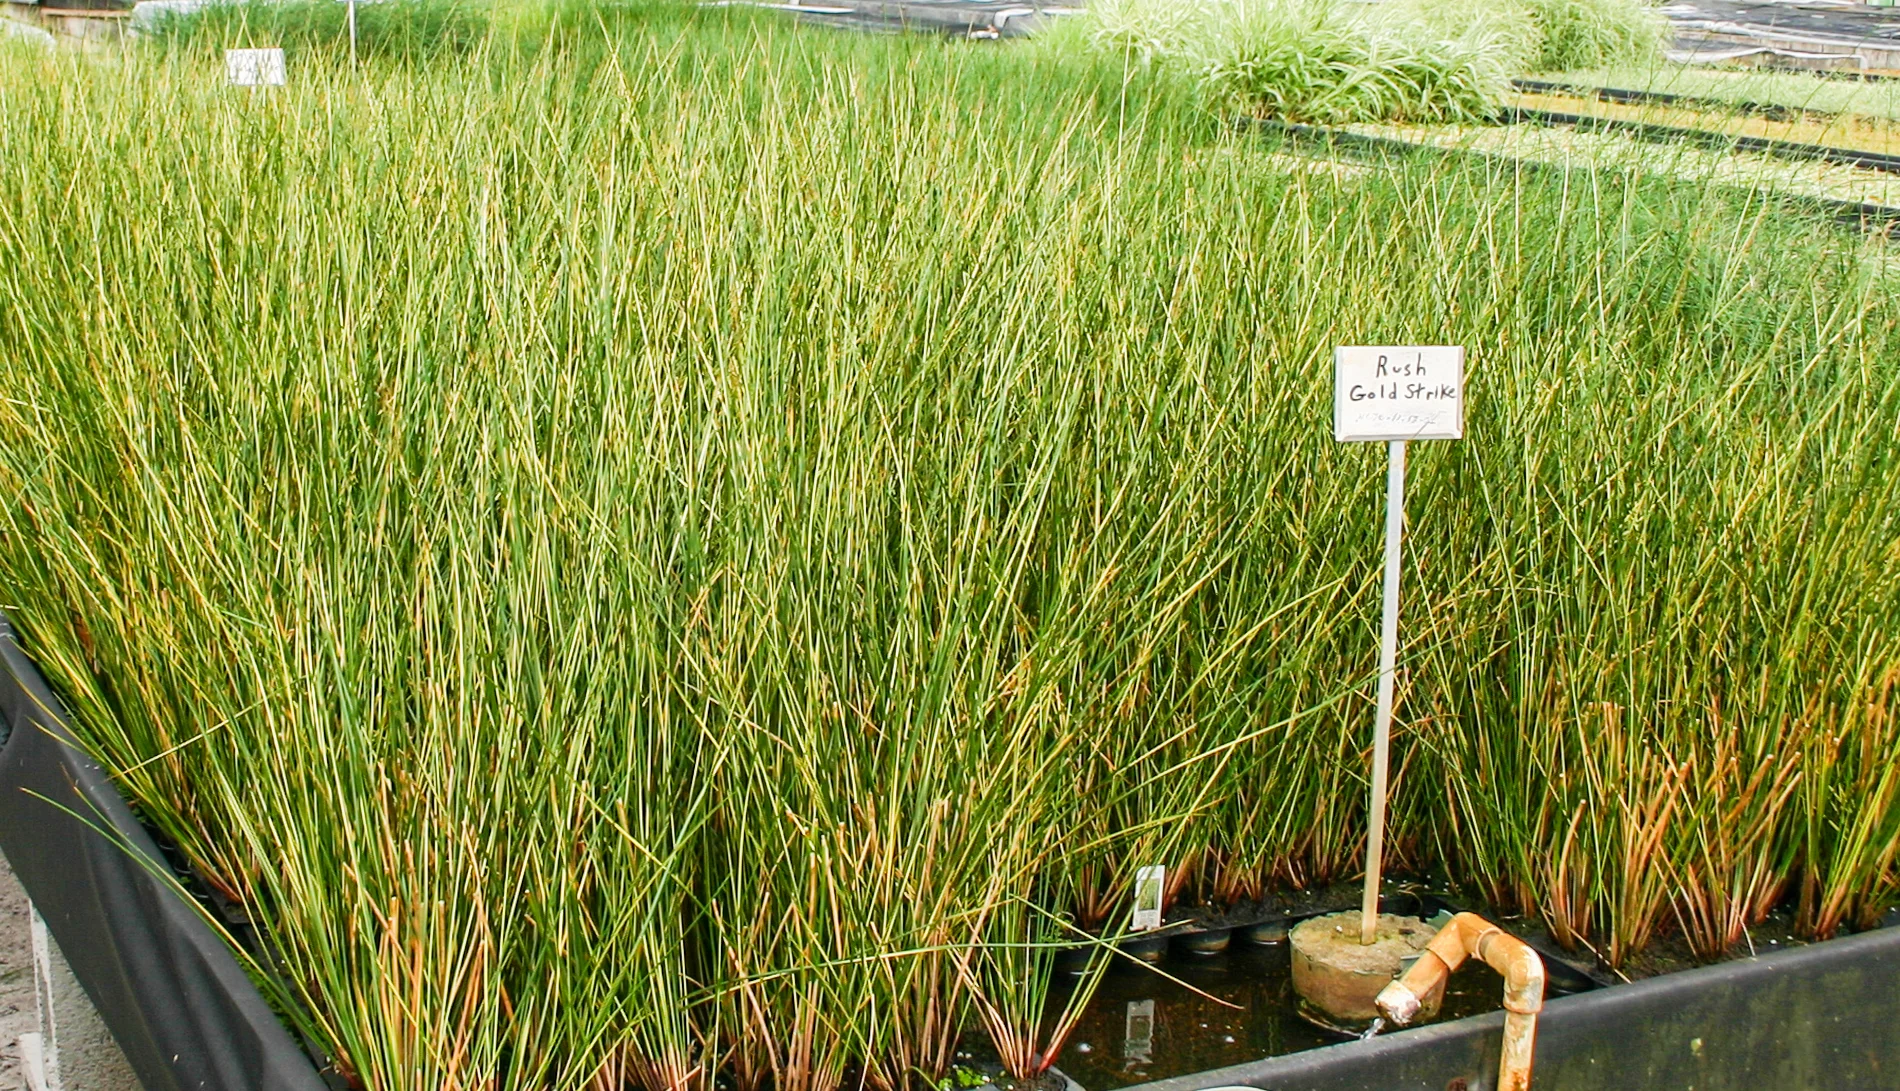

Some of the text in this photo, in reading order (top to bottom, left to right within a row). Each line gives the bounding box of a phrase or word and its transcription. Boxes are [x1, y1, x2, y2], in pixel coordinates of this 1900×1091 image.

[1376, 352, 1426, 378] Rush
[1349, 382, 1457, 401] Gold Strike
